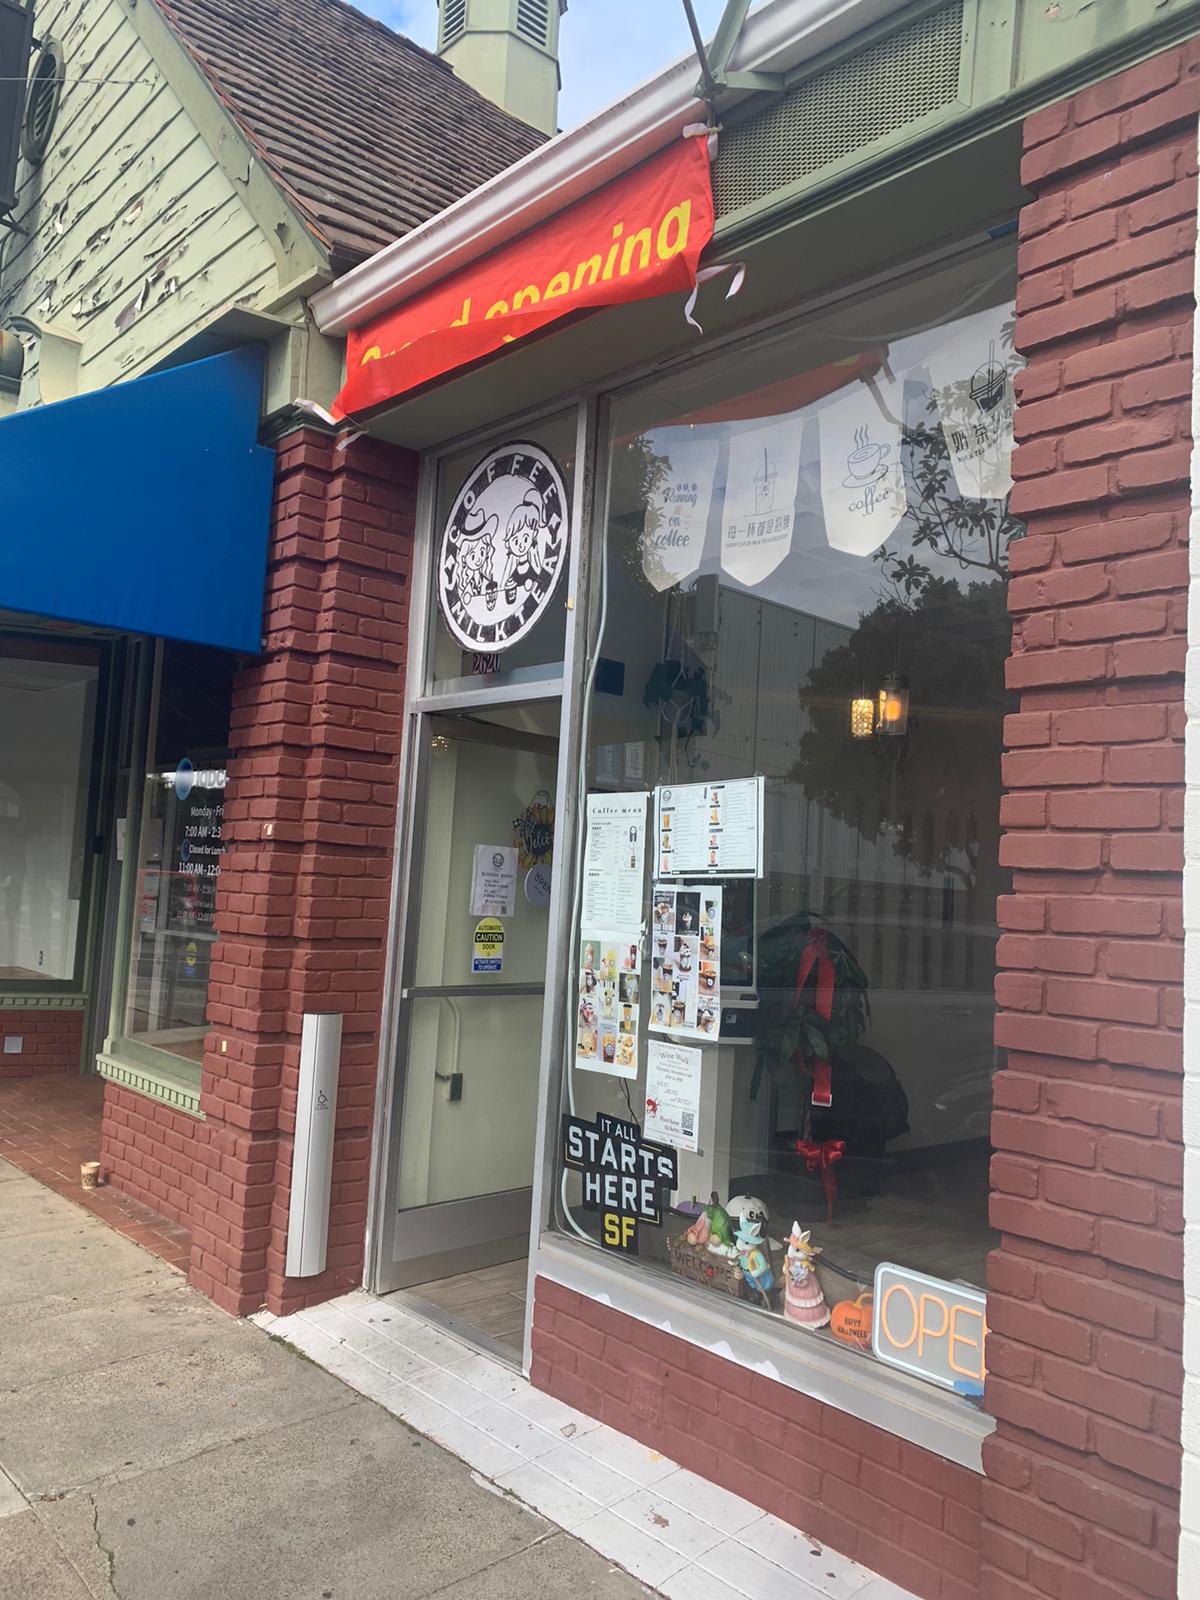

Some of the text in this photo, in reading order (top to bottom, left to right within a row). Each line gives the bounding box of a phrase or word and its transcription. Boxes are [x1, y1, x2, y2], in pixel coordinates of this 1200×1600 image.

[447, 454, 557, 544] COFFEE
[848, 484, 890, 517] coffee
[668, 516, 681, 527] on
[655, 529, 690, 547] coffee
[472, 652, 501, 674] 2620
[190, 806, 212, 819] Monday
[185, 826, 197, 837] 7:00
[198, 826, 208, 838] AM
[212, 827, 222, 838] 2:3
[189, 844, 204, 854] Closed
[178, 862, 194, 874] 11:00
[194, 863, 204, 875] AM
[208, 865, 220, 877] 12:0
[476, 933, 504, 942] CAUTION
[601, 1118, 612, 1133] IT
[615, 1125, 636, 1142] ALL
[569, 1125, 674, 1178] STARTS
[586, 1172, 655, 1216] HERE
[604, 1213, 636, 1248] SF
[845, 1316, 861, 1327] HAPPY
[836, 1325, 867, 1339] HALLOWEEN
[881, 1283, 987, 1381] OPE
